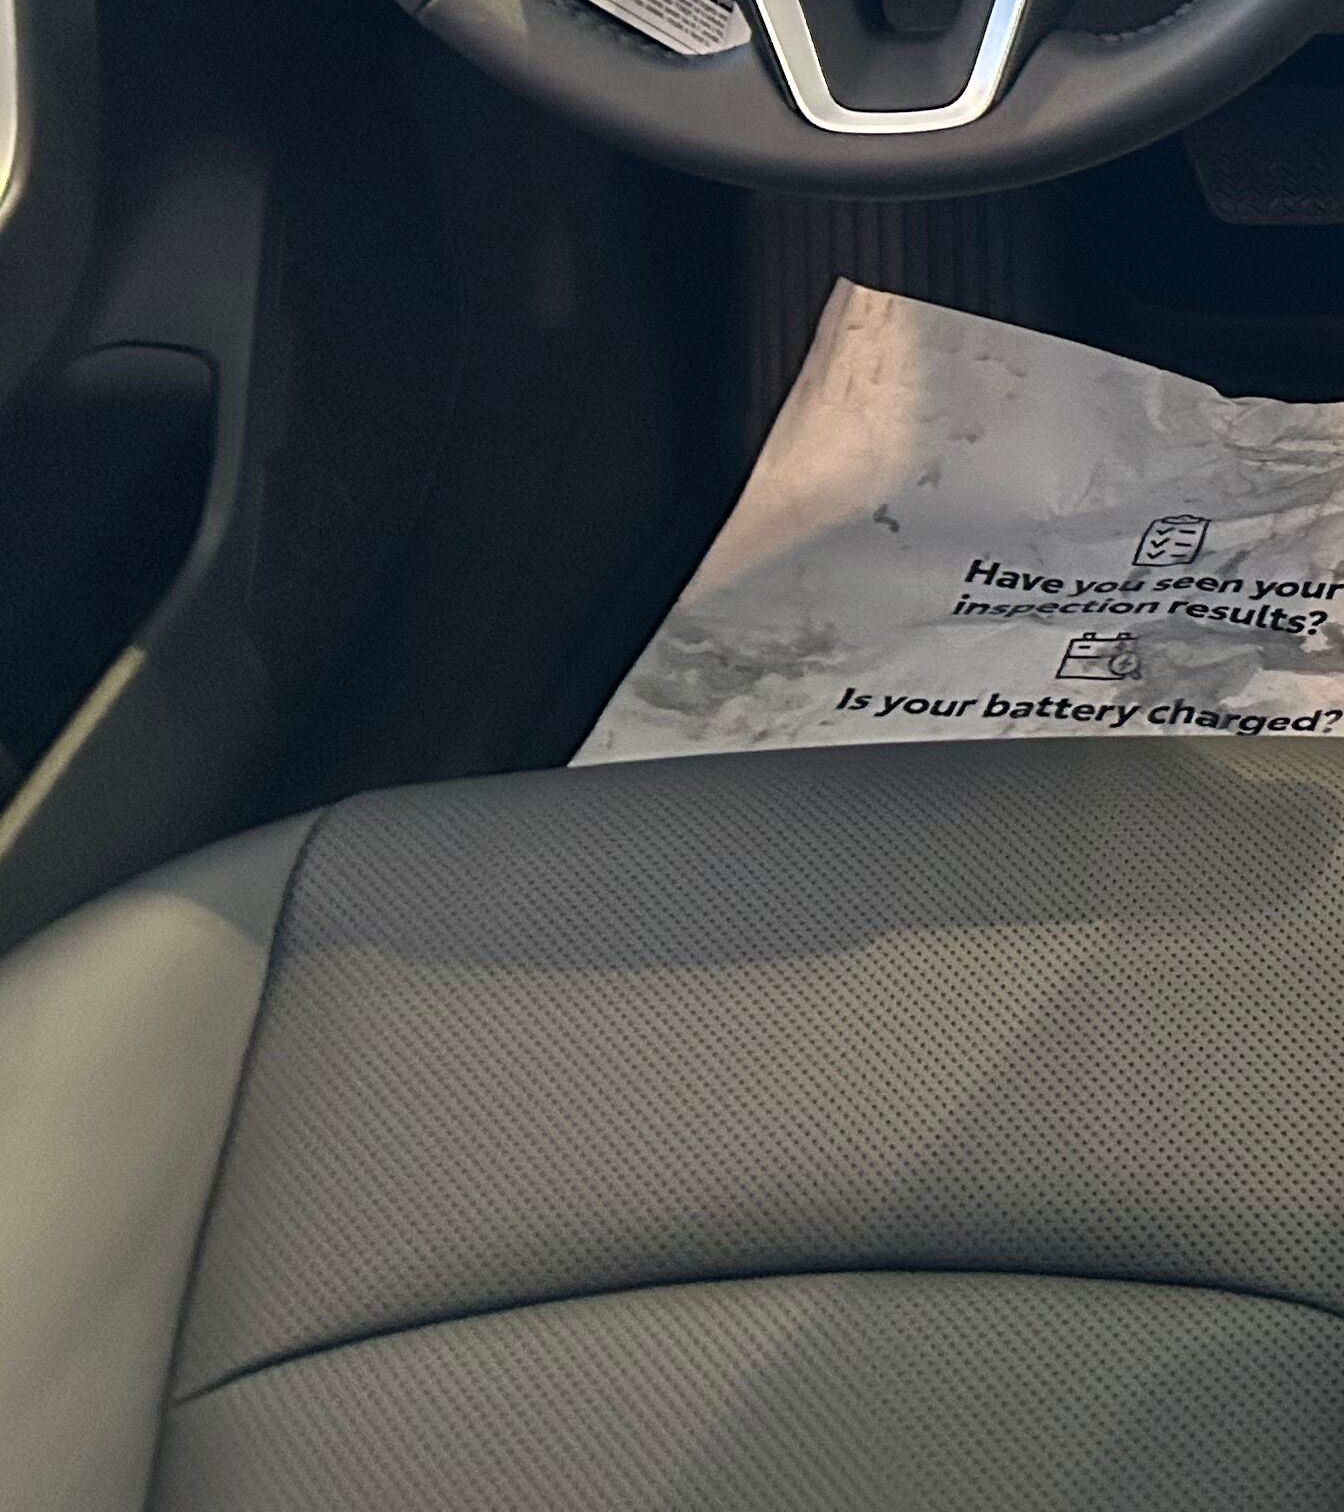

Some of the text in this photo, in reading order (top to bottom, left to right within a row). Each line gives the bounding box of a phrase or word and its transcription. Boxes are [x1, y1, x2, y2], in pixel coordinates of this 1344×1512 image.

[963, 558, 1064, 595] Have
[1073, 575, 1146, 597] you
[1152, 573, 1243, 595] seen
[951, 593, 1329, 637] inspection results?
[836, 686, 1344, 738] Is your battery charged?
